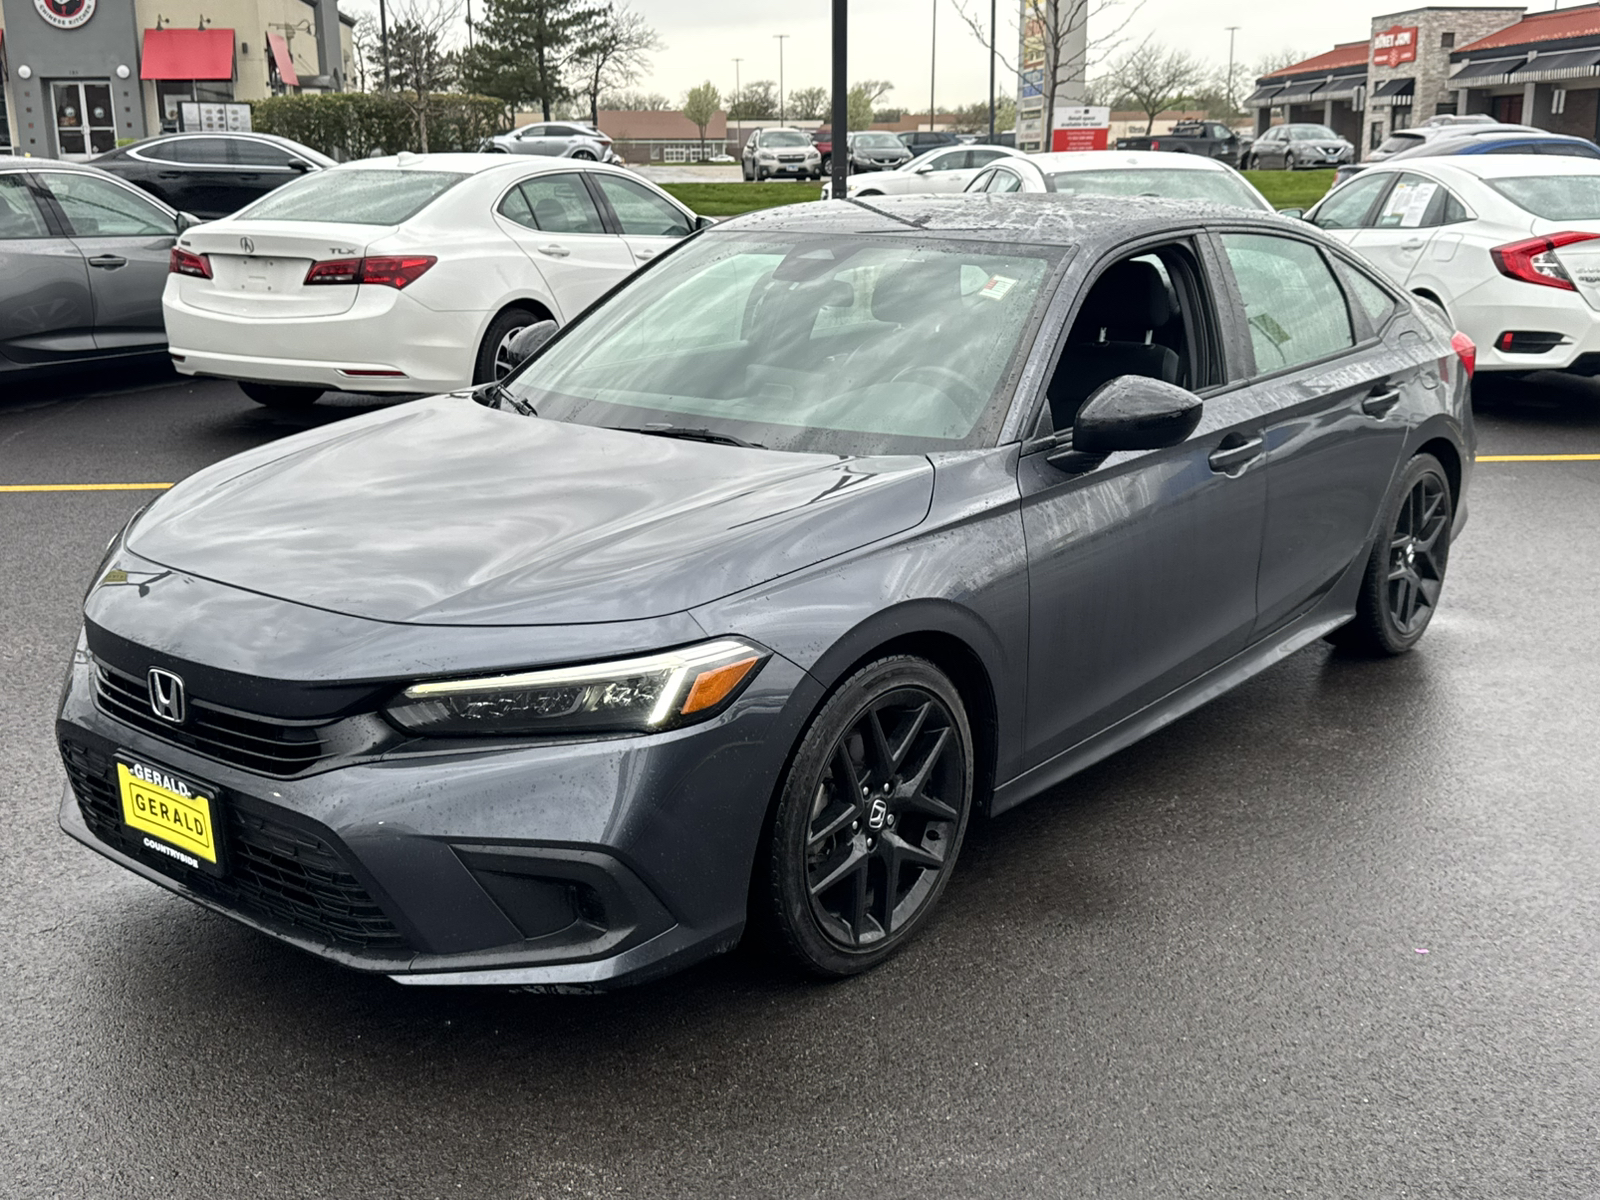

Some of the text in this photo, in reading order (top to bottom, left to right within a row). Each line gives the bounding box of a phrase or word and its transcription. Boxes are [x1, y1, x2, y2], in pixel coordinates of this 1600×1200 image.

[39, 4, 92, 25] CHINESE KITCHEN
[133, 763, 190, 798] GERALD
[135, 793, 204, 836] GERALD
[143, 837, 199, 869] COUNTRYSIDE
